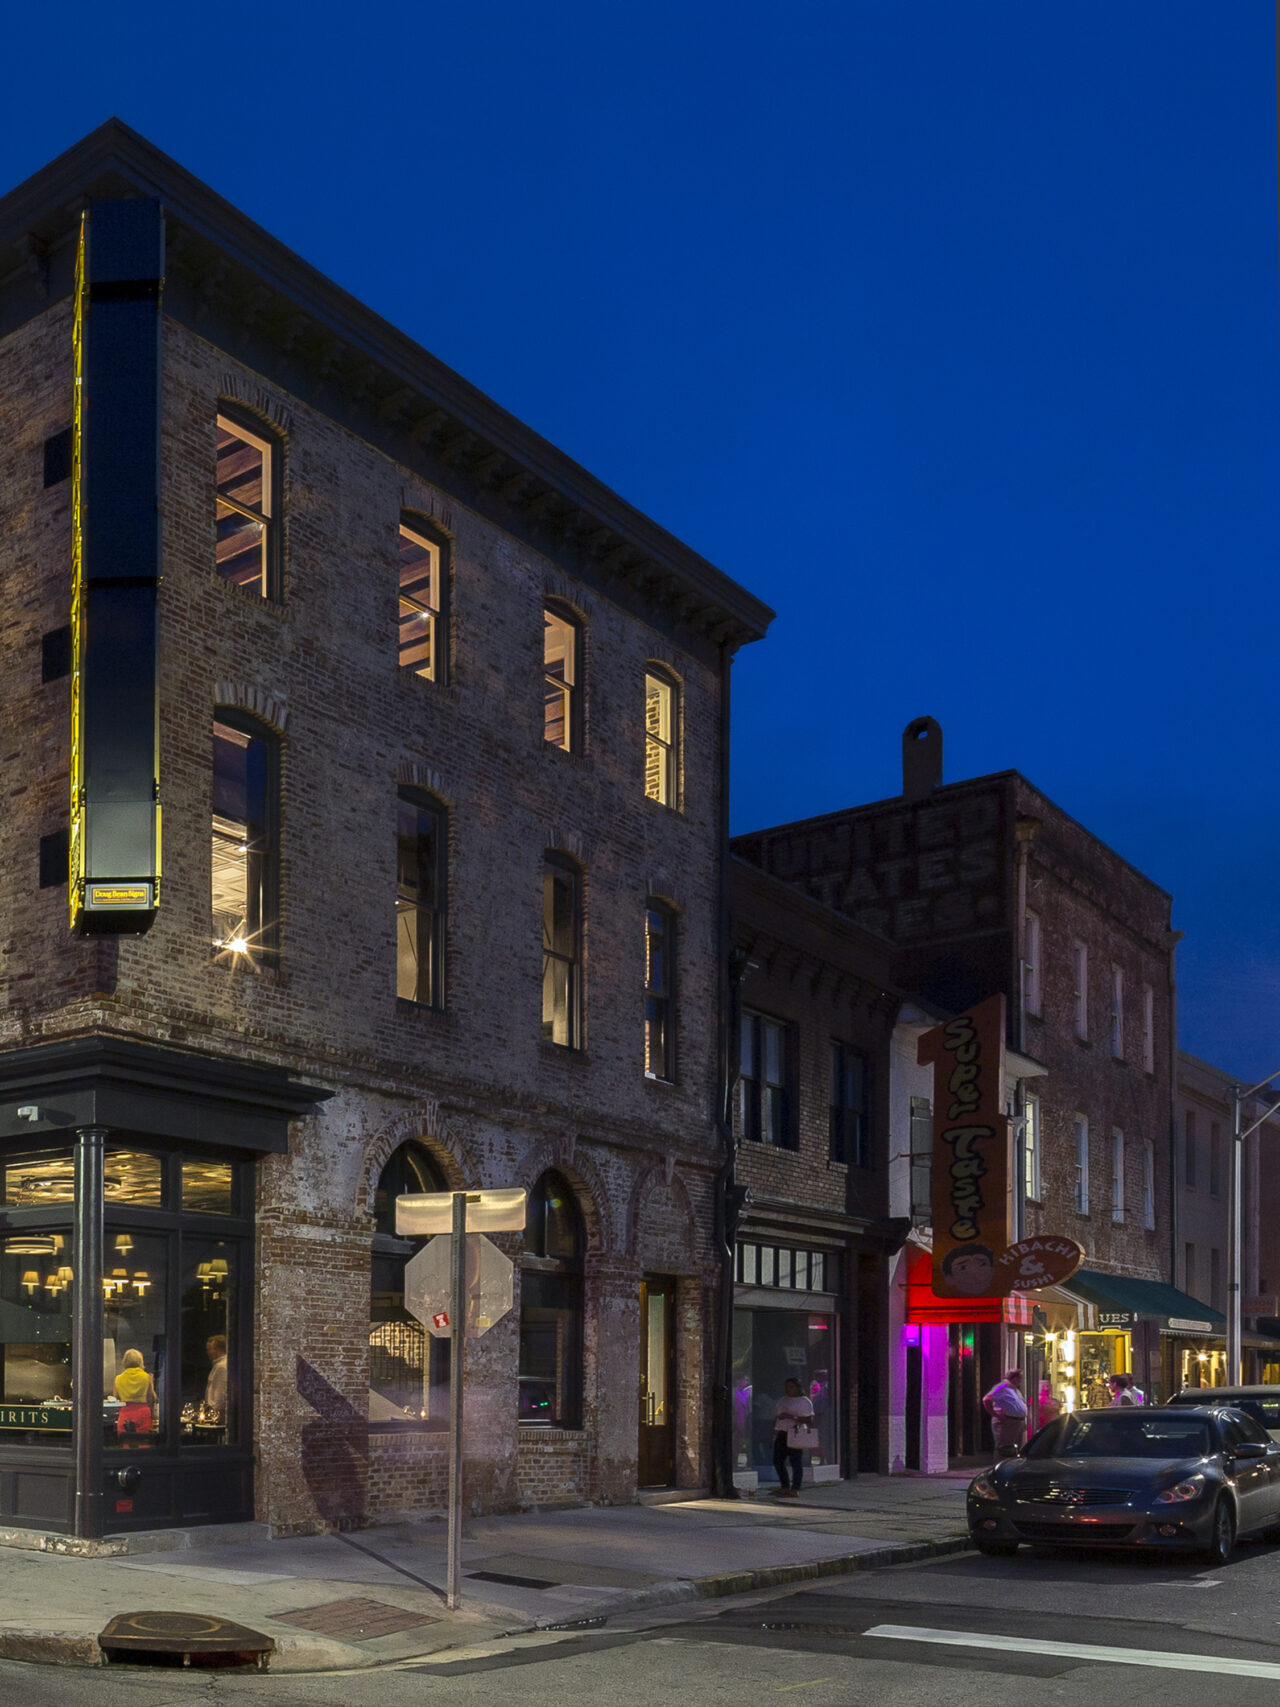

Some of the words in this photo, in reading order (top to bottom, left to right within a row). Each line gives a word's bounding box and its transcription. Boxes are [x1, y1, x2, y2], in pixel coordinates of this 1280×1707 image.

[772, 795, 999, 876] UNITED
[1000, 1241, 1078, 1265] HIBACHI
[1019, 1255, 1045, 1275] &
[1013, 1273, 1055, 1289] SUSHI
